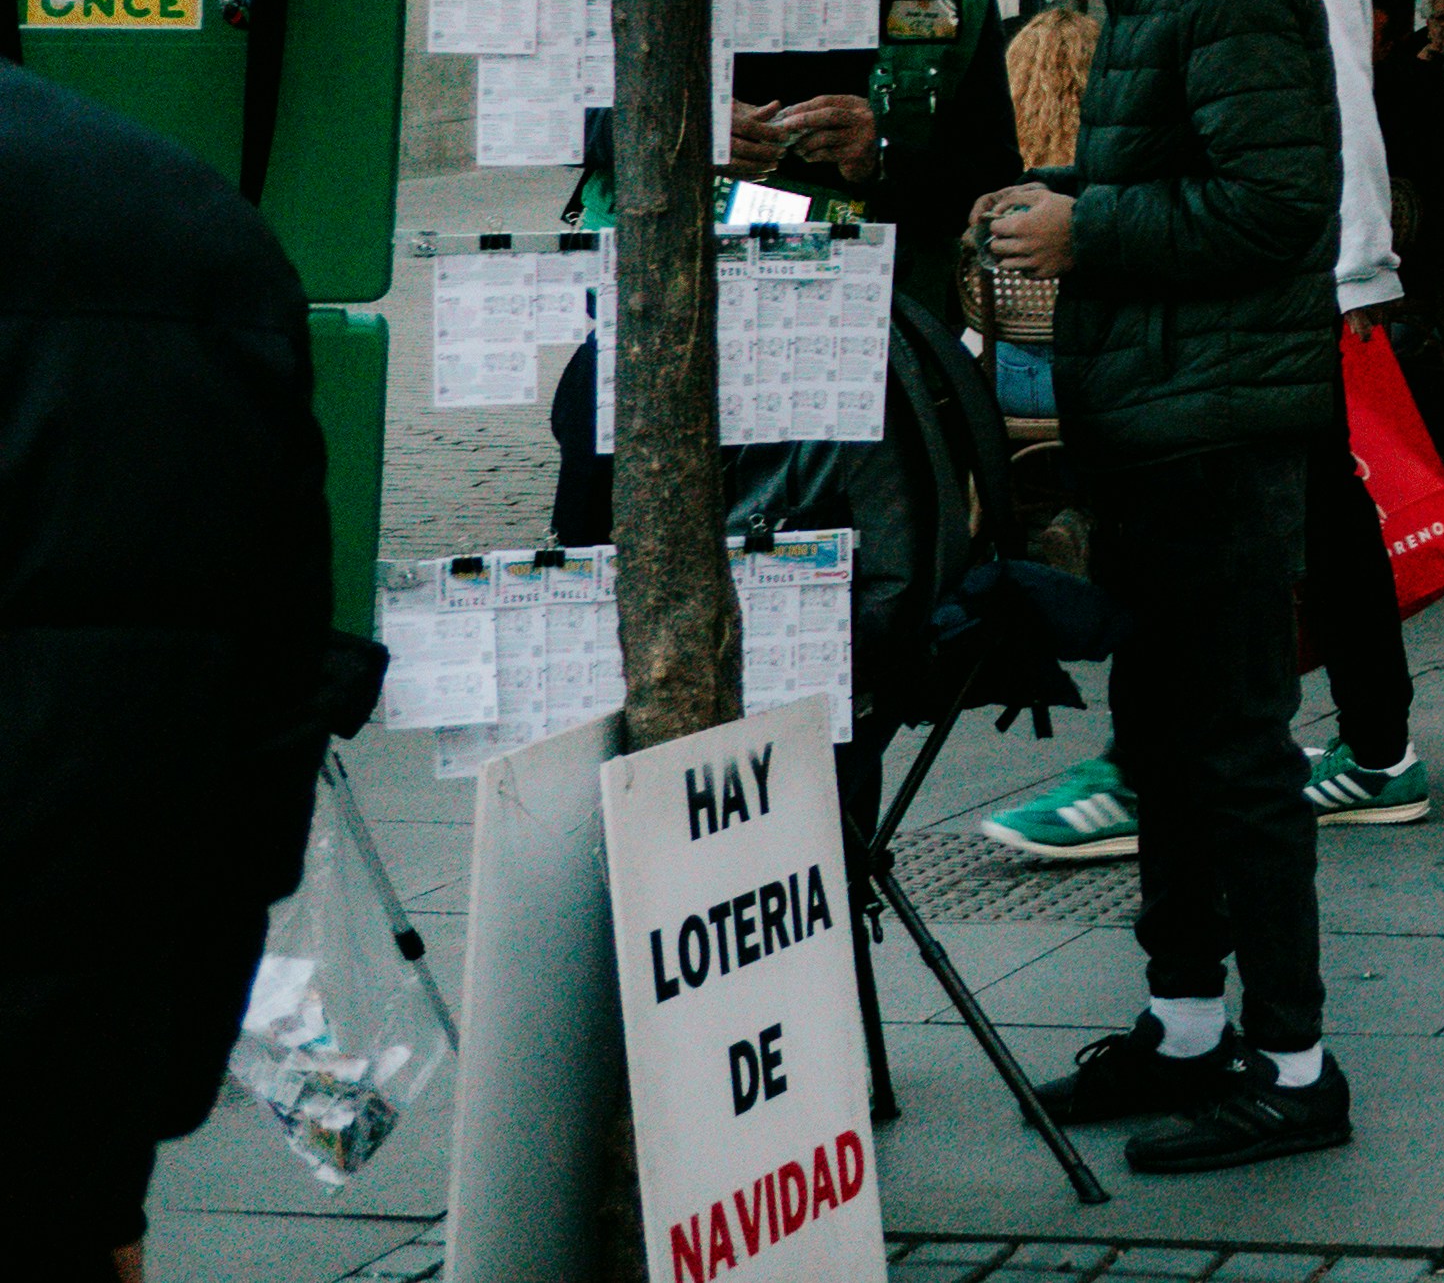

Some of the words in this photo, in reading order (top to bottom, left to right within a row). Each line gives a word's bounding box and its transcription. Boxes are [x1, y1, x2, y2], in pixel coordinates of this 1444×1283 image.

[684, 741, 774, 842] HAY
[649, 863, 834, 1005] LOTERIA
[727, 1022, 789, 1117] DE
[668, 1128, 865, 1283] NAVIDAD
